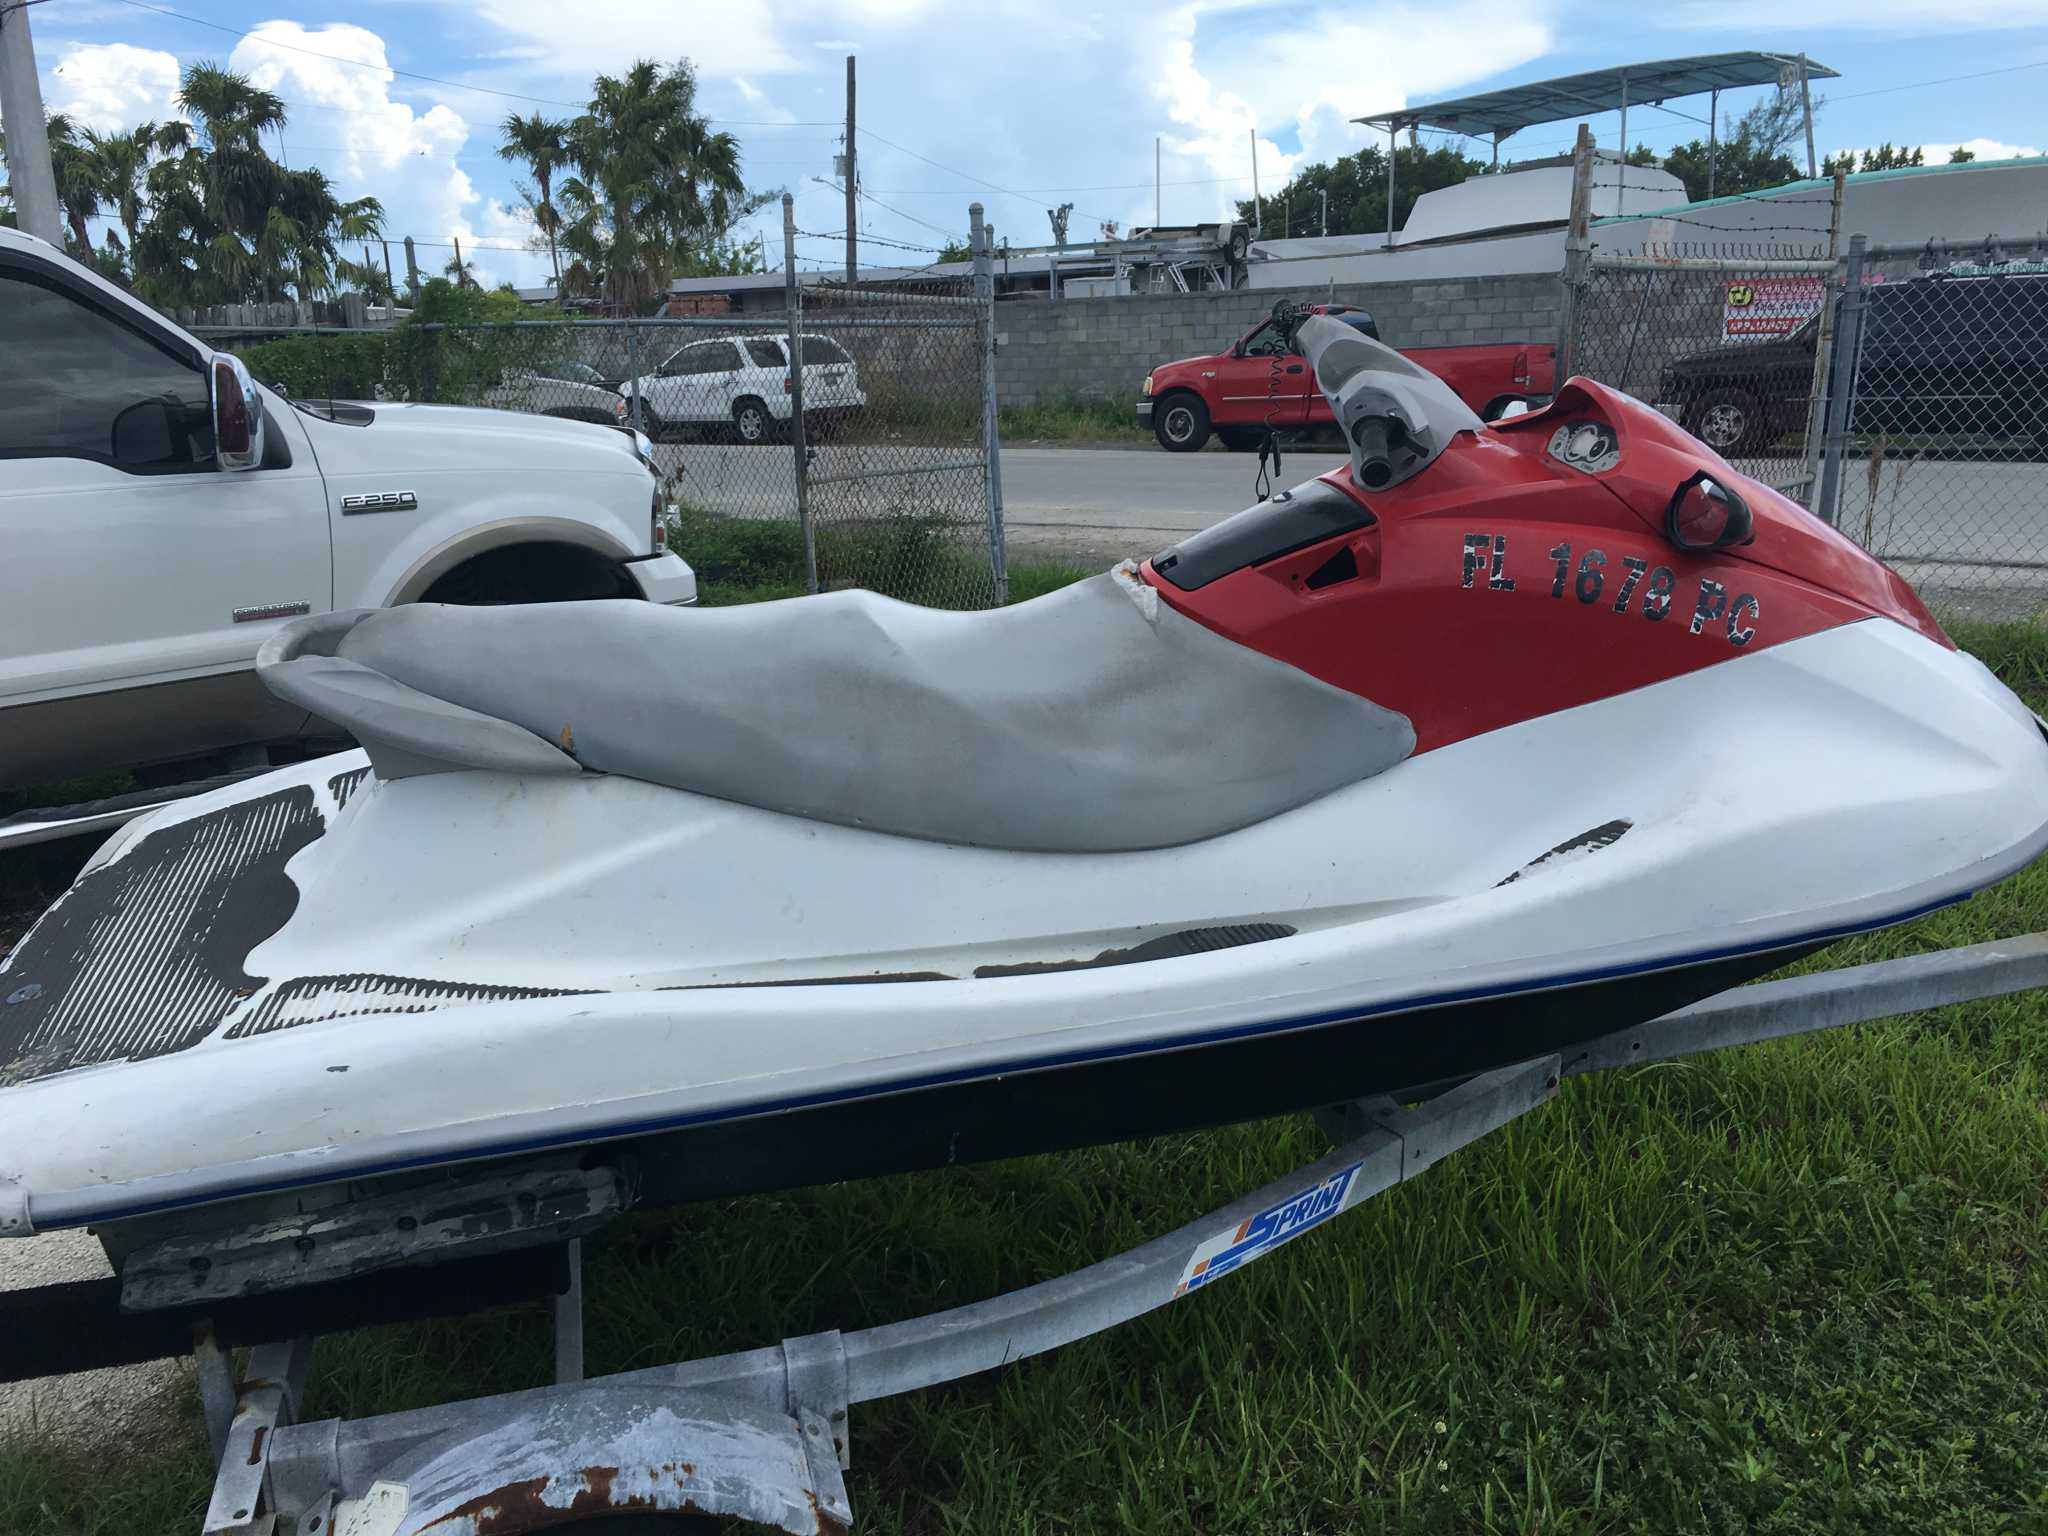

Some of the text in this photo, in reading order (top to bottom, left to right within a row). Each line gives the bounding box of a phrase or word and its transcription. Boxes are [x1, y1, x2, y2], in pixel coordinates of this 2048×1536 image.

[1461, 533, 1759, 647] FL 1678 PC
[1238, 1162, 1363, 1246] SPRINT
